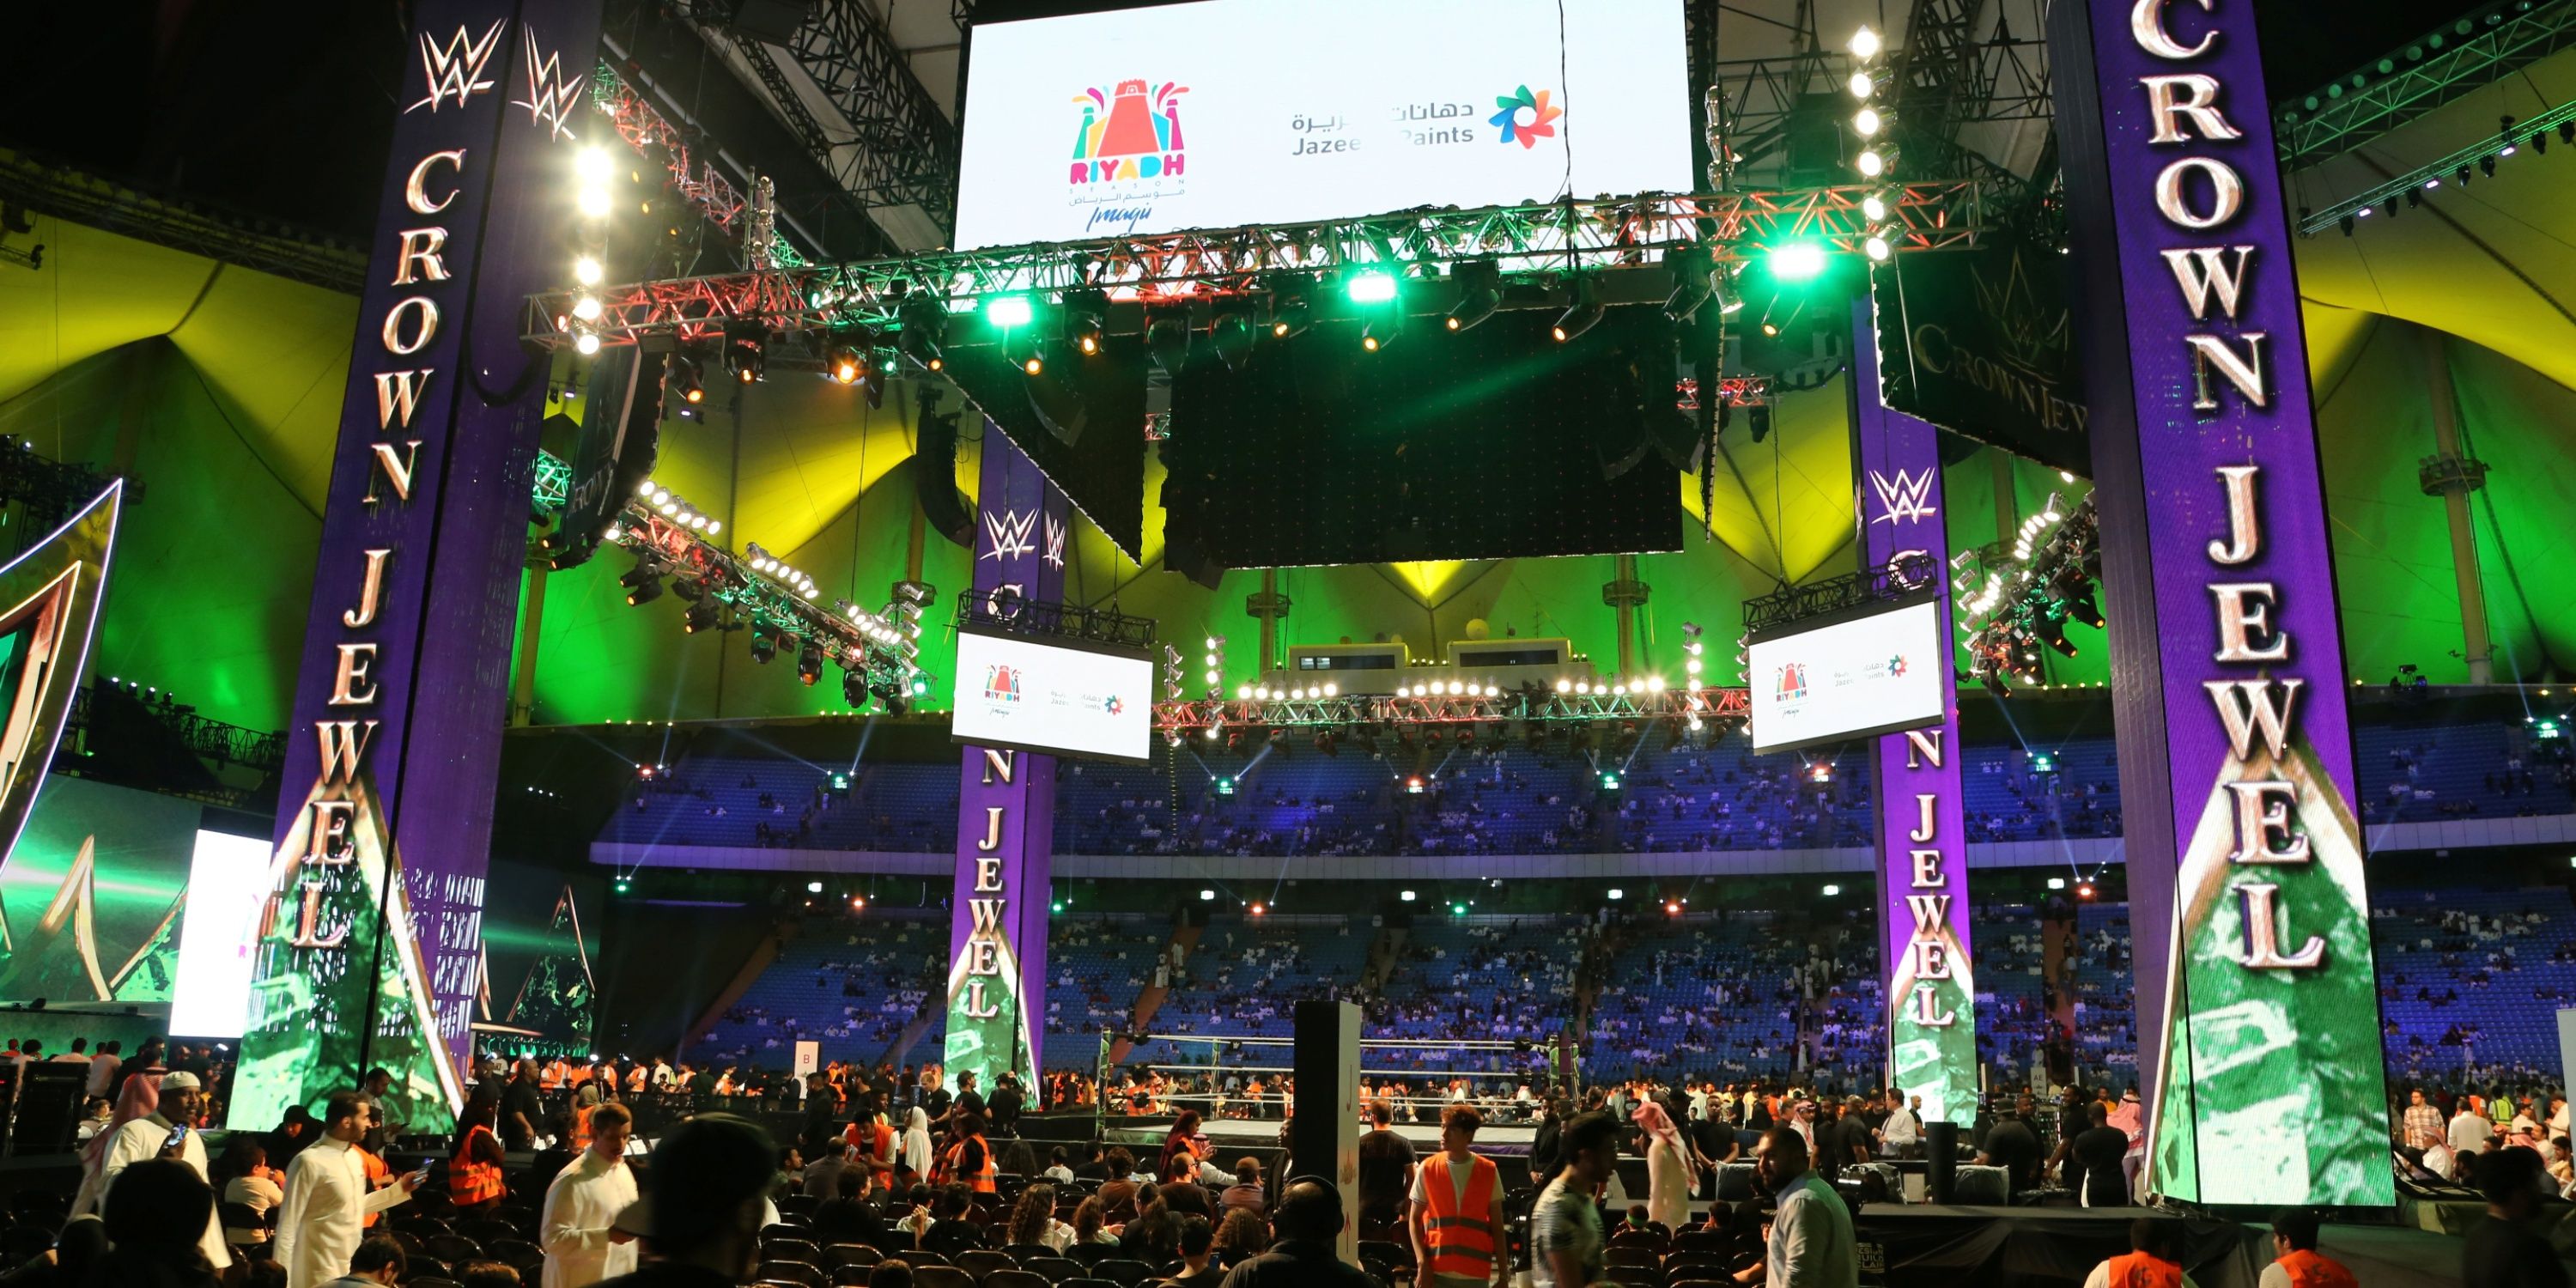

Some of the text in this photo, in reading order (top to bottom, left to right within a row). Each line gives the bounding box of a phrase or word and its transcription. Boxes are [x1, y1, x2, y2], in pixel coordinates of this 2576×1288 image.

[1070, 154, 1184, 184] RIYADH
[2129, 0, 2324, 969] CROWN JEWEL
[293, 149, 466, 946] CROWN JEWEL
[985, 690, 1019, 702] RIYADH
[1777, 690, 1807, 702] RIYADH
[967, 807, 1006, 1019] JEWEL
[1905, 794, 1955, 1026] JEWEL
[803, 1054, 810, 1064] B
